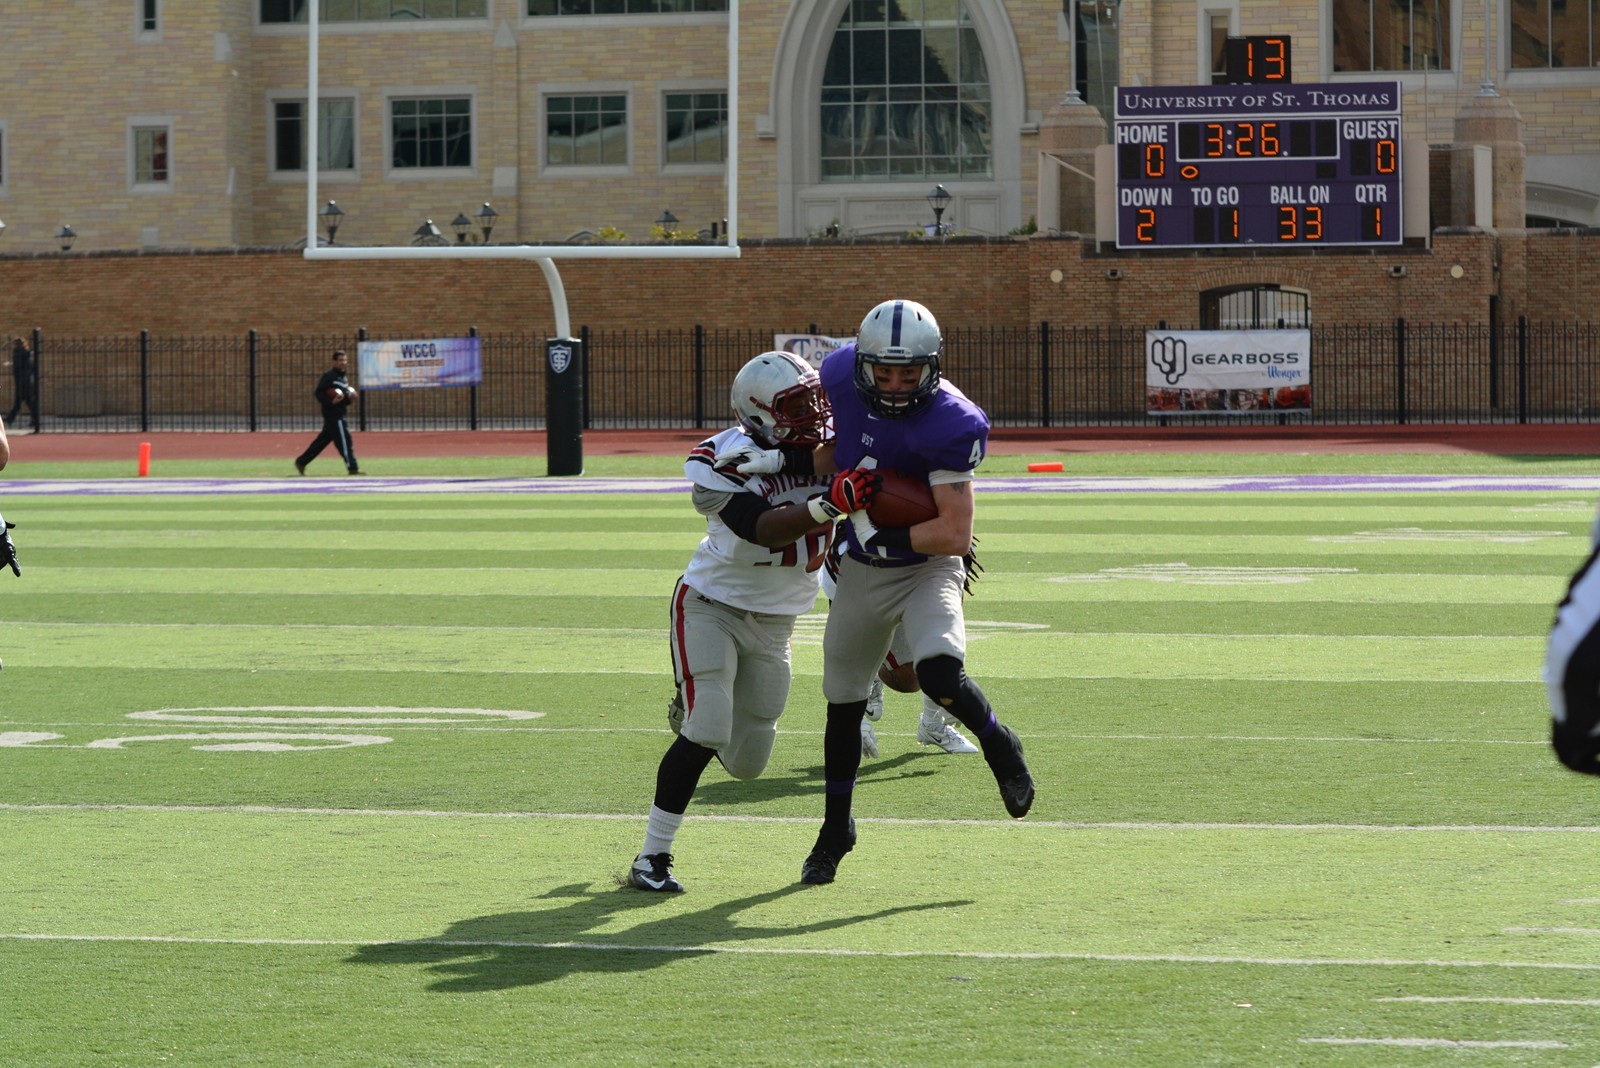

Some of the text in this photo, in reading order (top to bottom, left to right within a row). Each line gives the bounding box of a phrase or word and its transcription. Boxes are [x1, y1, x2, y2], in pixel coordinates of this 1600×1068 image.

[1247, 39, 1285, 79] 13
[1124, 94, 1236, 109] UNIVERSITY
[1242, 95, 1266, 107] OF
[1307, 91, 1390, 106] THOMAS
[1117, 125, 1168, 144] HOME
[1343, 120, 1397, 139] GUEST
[1146, 144, 1164, 177] 0
[1376, 140, 1395, 173] 0
[1121, 188, 1172, 206] DOWN
[1191, 187, 1239, 206] TO GO
[1270, 185, 1329, 204] BALL ON
[1355, 184, 1387, 202] QTR
[1137, 209, 1155, 241] 2
[1232, 209, 1239, 238] 1
[1280, 206, 1322, 239] 33
[1374, 207, 1381, 237] 1
[401, 343, 437, 358] WCCO
[1191, 353, 1299, 365] GEARBOSS
[861, 432, 874, 448] UST
[968, 438, 982, 467] 4
